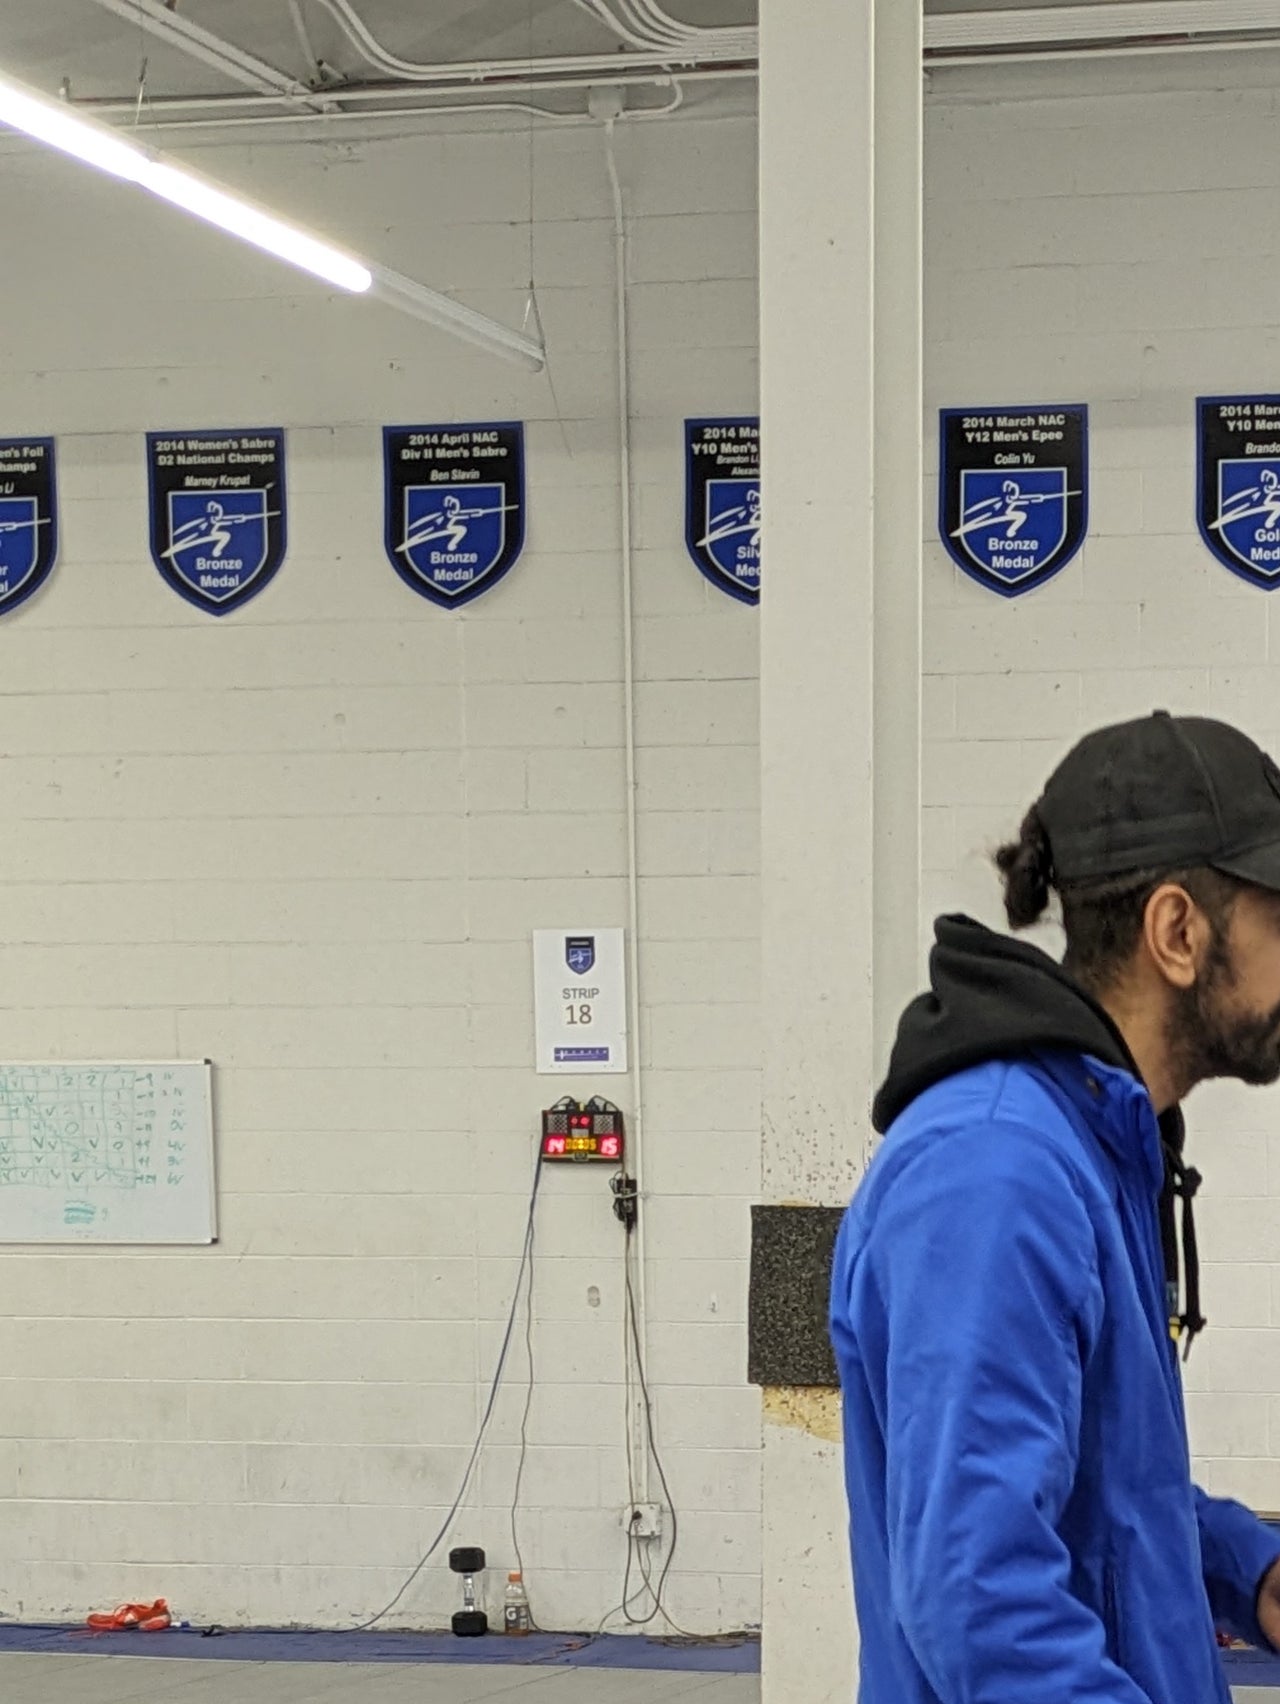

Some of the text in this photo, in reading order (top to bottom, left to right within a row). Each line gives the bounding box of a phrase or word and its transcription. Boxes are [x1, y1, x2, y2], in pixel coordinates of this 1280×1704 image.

[1220, 405, 1251, 417] 2014
[962, 414, 1065, 428] 2014 March NAC
[1227, 420, 1251, 431] Y10
[409, 431, 498, 446] 2014 April NAC
[703, 427, 736, 439] 2014
[965, 430, 1063, 443] Y12 Men's Epee
[156, 438, 275, 451] 2014 Women's Sabre
[691, 441, 758, 455] Y10 Men's
[0, 447, 44, 458] en's Foil
[401, 449, 421, 460] Div
[435, 447, 470, 458] Men's
[472, 446, 508, 457] Sabre
[994, 453, 1035, 465] Colin Yu
[158, 453, 275, 466] D2 National Champs
[0, 462, 37, 473] hamps
[430, 469, 449, 481] Ben
[988, 537, 1038, 551] Bronze
[430, 551, 478, 564] Bronze
[737, 546, 760, 559] Silv
[196, 557, 242, 570] Bronze
[992, 555, 1034, 568] Medal
[201, 575, 239, 587] Medal
[434, 568, 474, 581] Medal
[562, 987, 600, 1000] STRIP
[565, 1004, 592, 1025] 18
[506, 1607, 517, 1621] G
